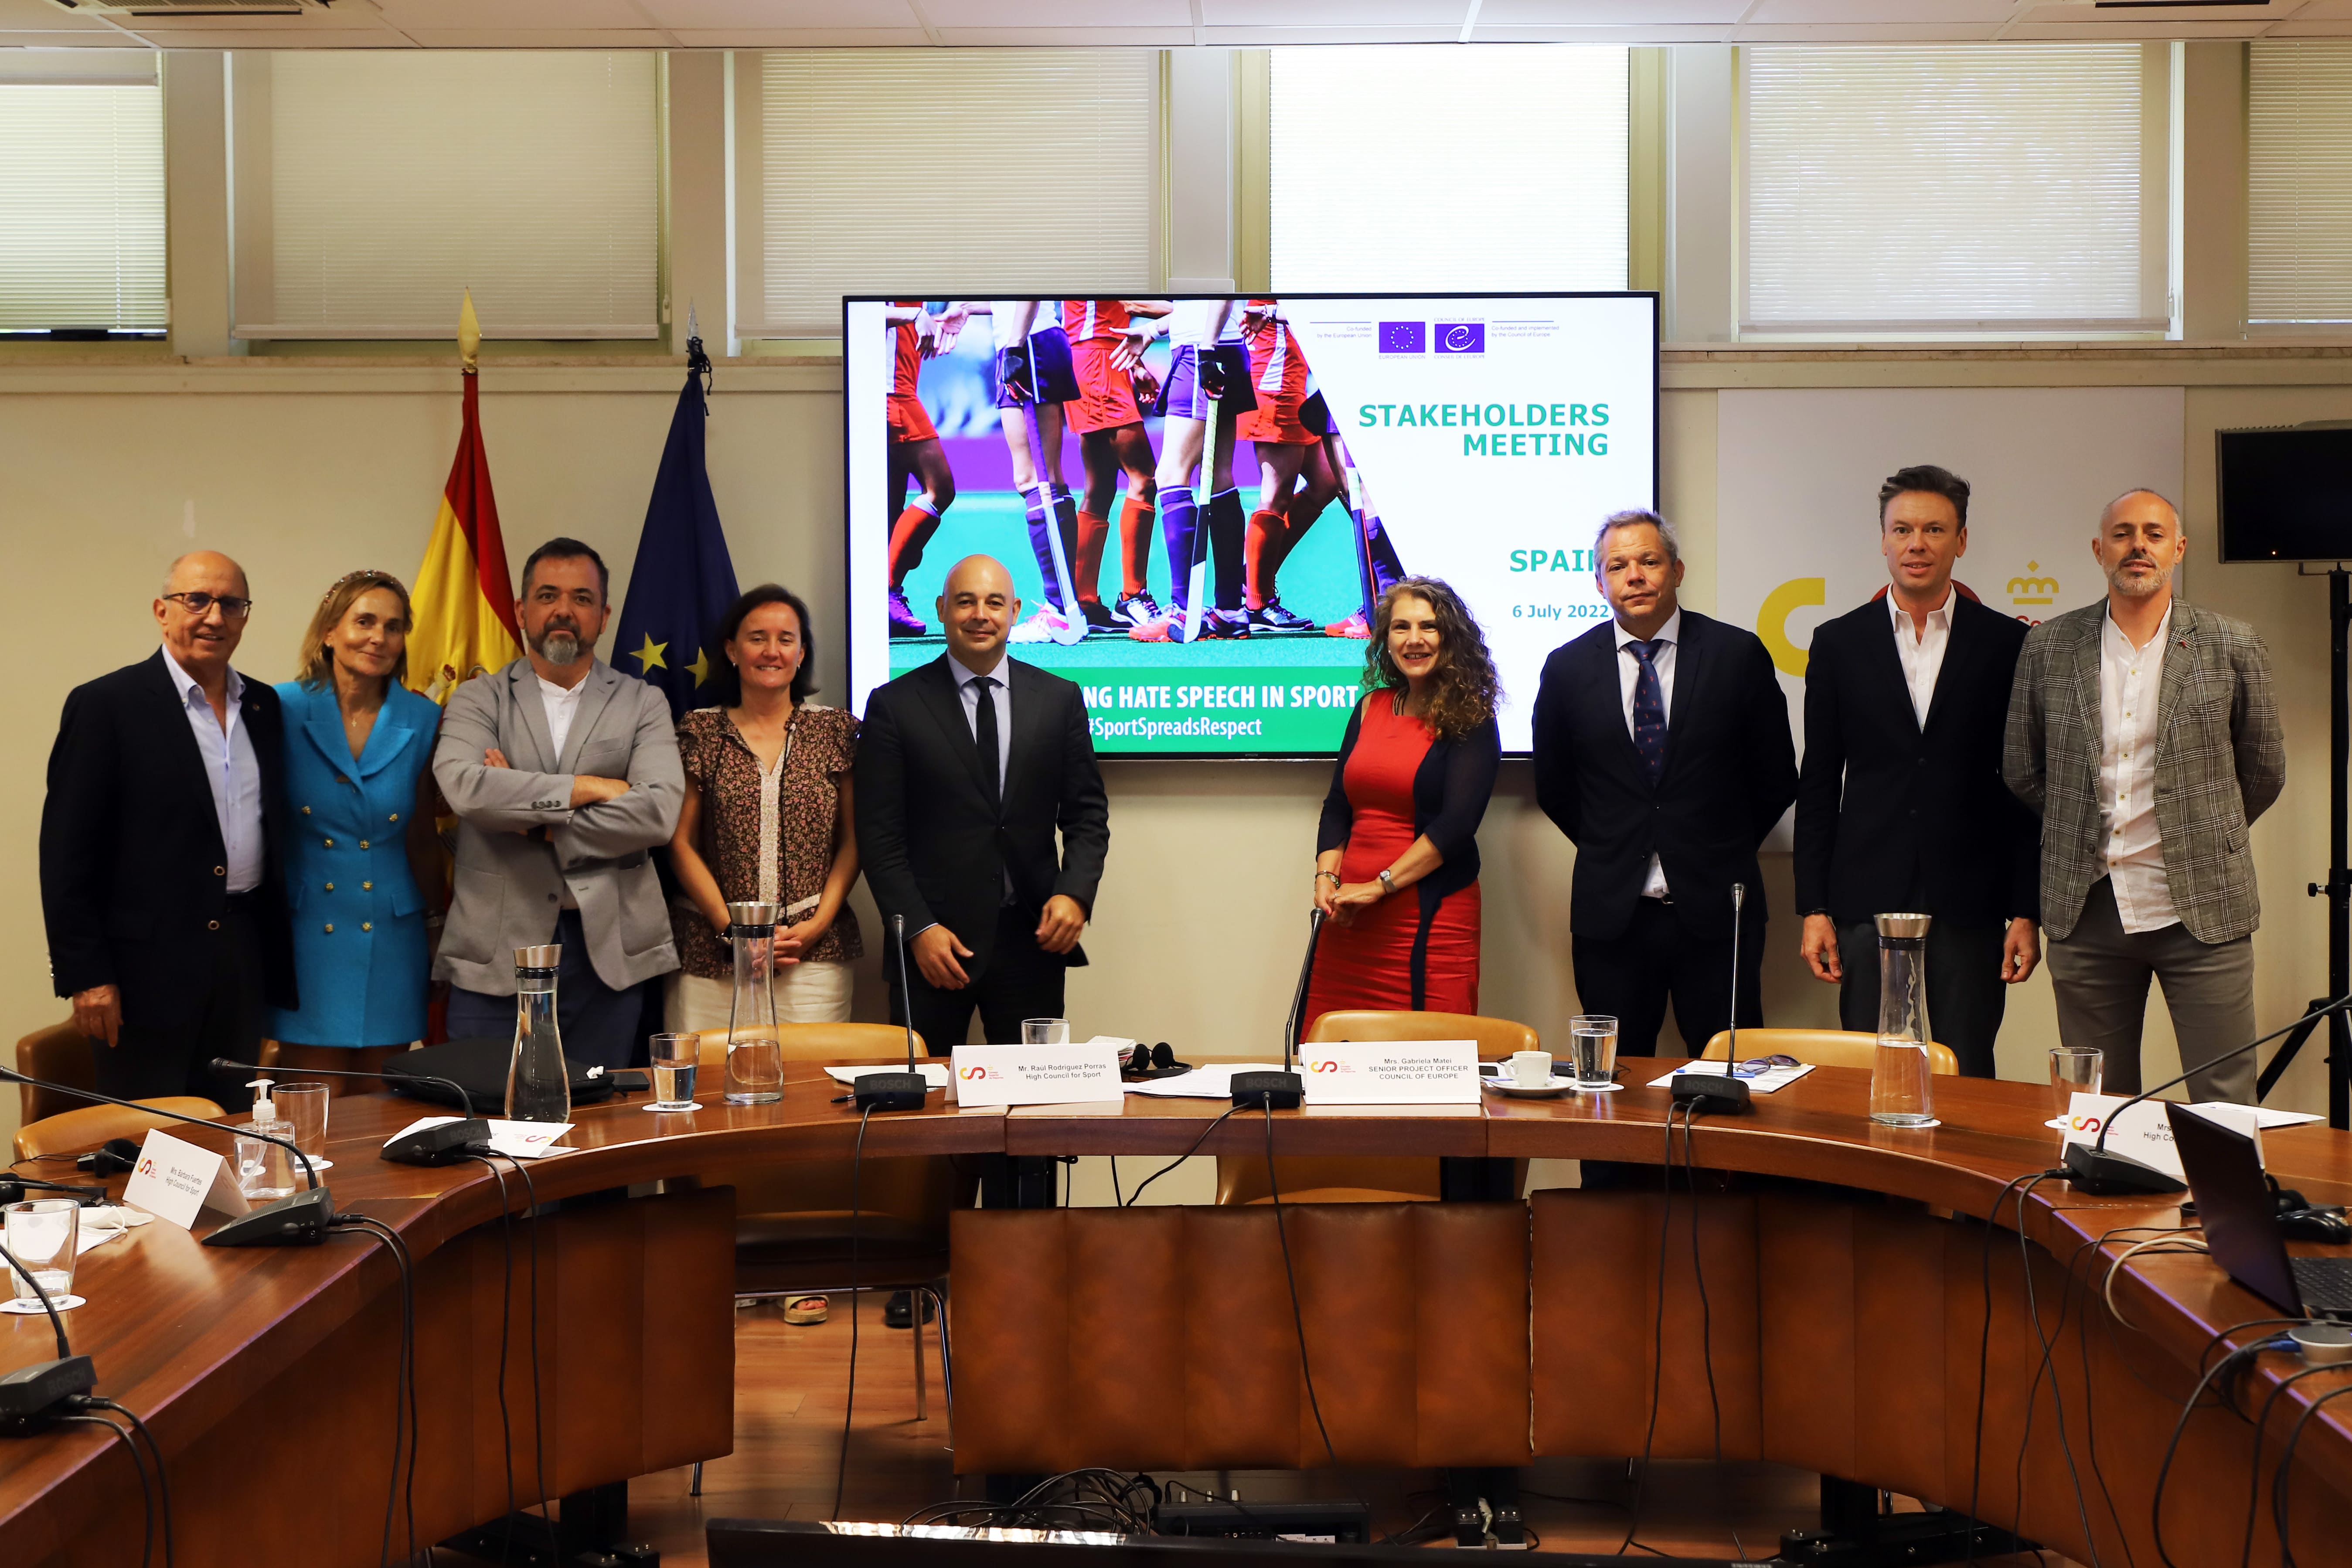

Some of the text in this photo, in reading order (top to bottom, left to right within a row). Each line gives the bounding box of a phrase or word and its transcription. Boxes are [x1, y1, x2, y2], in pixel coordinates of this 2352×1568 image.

[1359, 404, 1609, 427] STAKEHOLDERS
[1464, 434, 1608, 456] MEETING
[1510, 550, 1594, 572] SPAI
[1512, 604, 1609, 621] 6 July 2022
[1080, 685, 1359, 708] NG HATE SPEECH IN SPORT
[1088, 717, 1263, 740] #SportSpreadsRespect
[870, 1079, 911, 1089] BOSCH
[1245, 1077, 1287, 1088] BOSCH
[1685, 1080, 1723, 1092] BOSCH
[449, 1126, 482, 1142] BOSCH
[2144, 1132, 2161, 1141] High
[173, 1179, 186, 1190] Council
[190, 1187, 200, 1196] Sport
[48, 1367, 86, 1395] BOSCH
